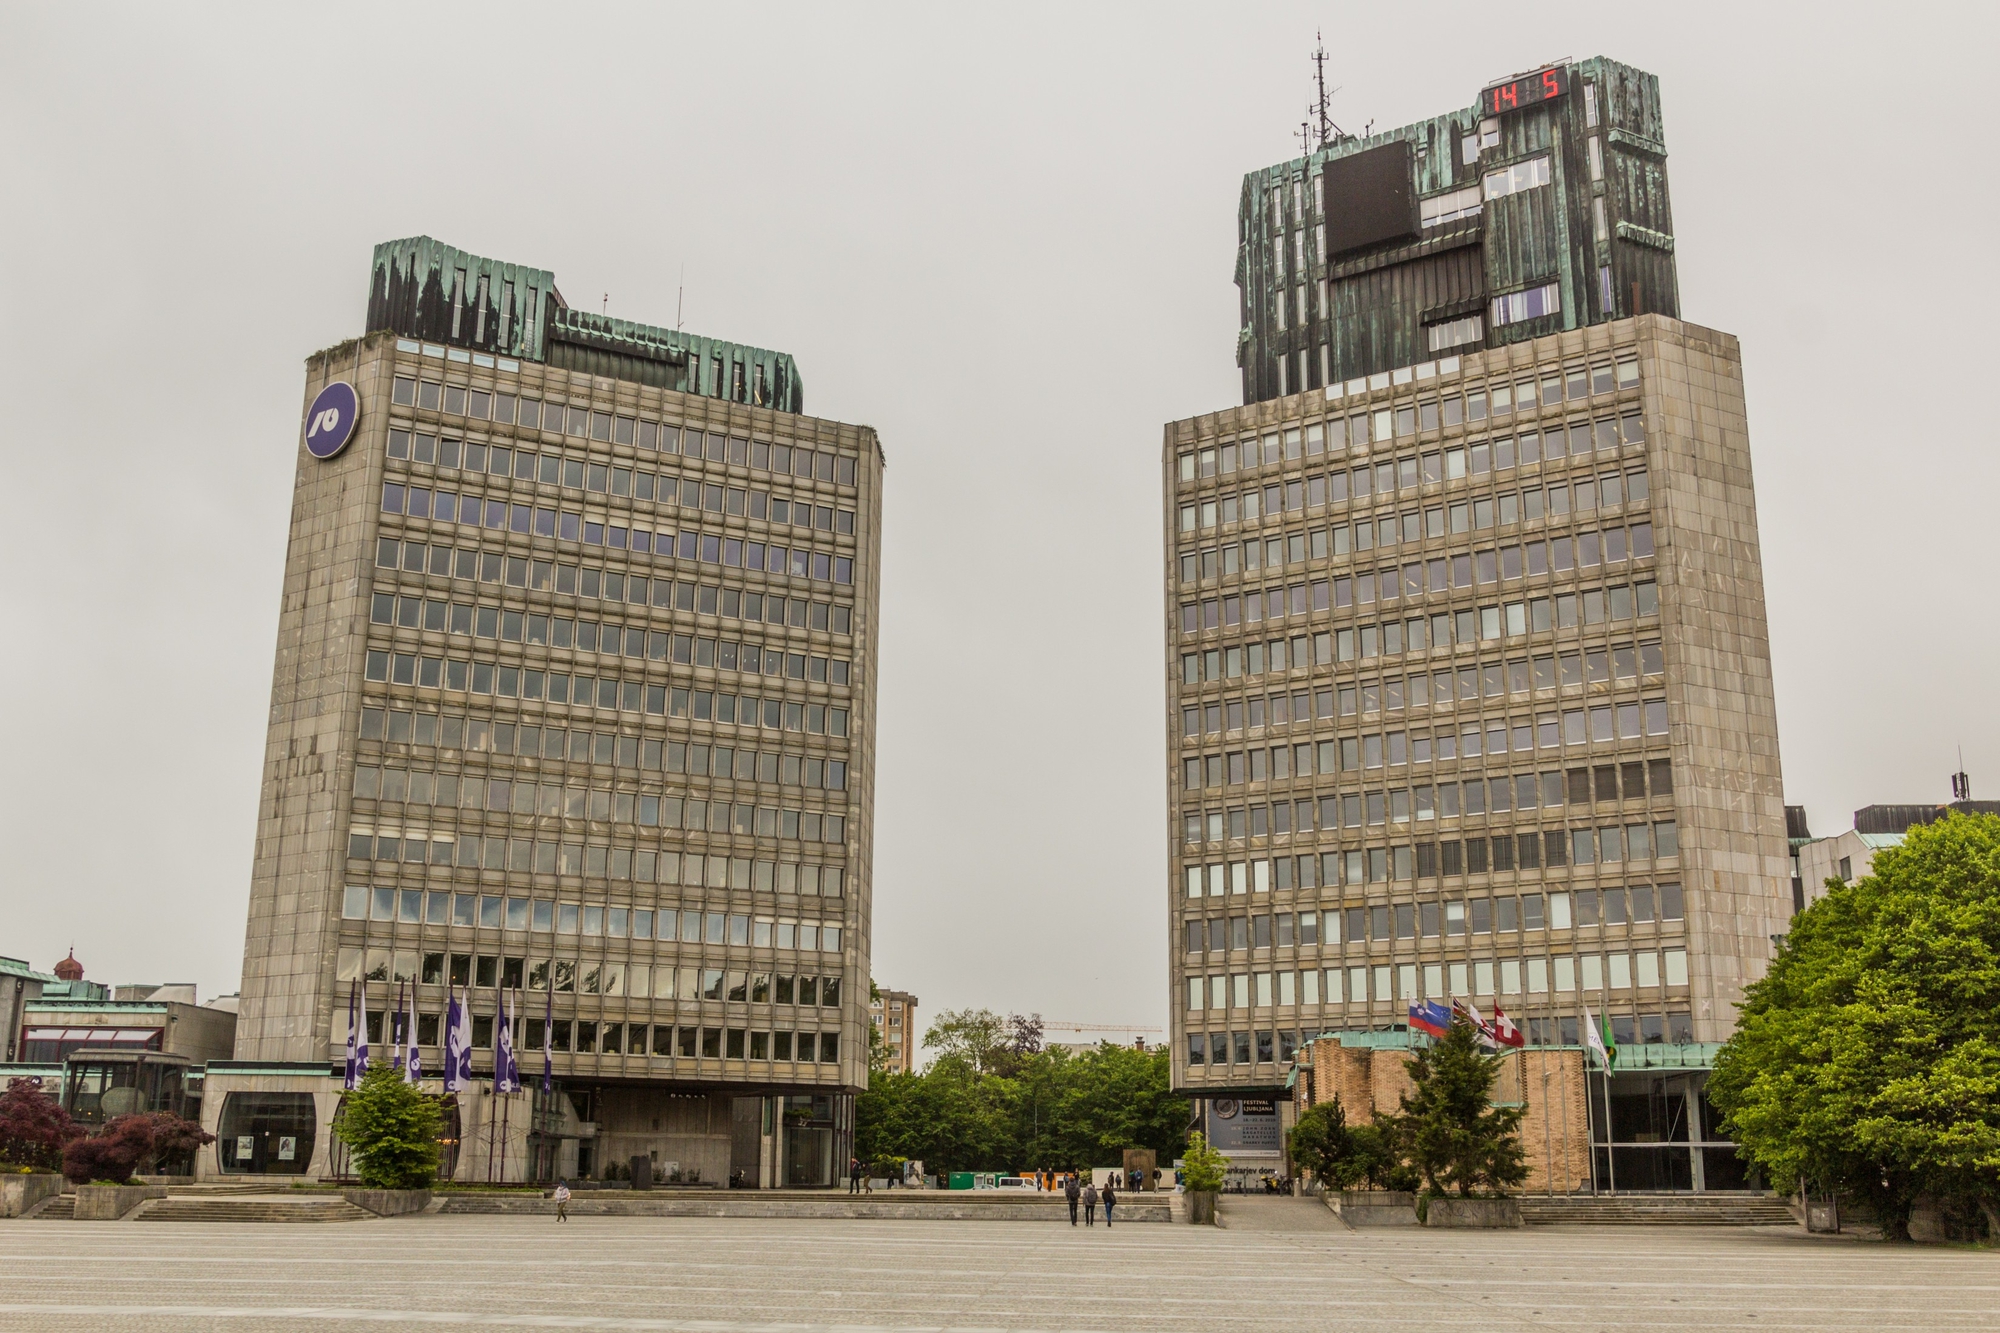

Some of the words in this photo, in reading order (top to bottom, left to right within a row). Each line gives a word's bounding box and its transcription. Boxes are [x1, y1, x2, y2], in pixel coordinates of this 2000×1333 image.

[1493, 82, 1517, 112] 14
[1542, 69, 1559, 99] 5
[1226, 1166, 1257, 1176] ankarjev
[1258, 1166, 1276, 1174] dom
